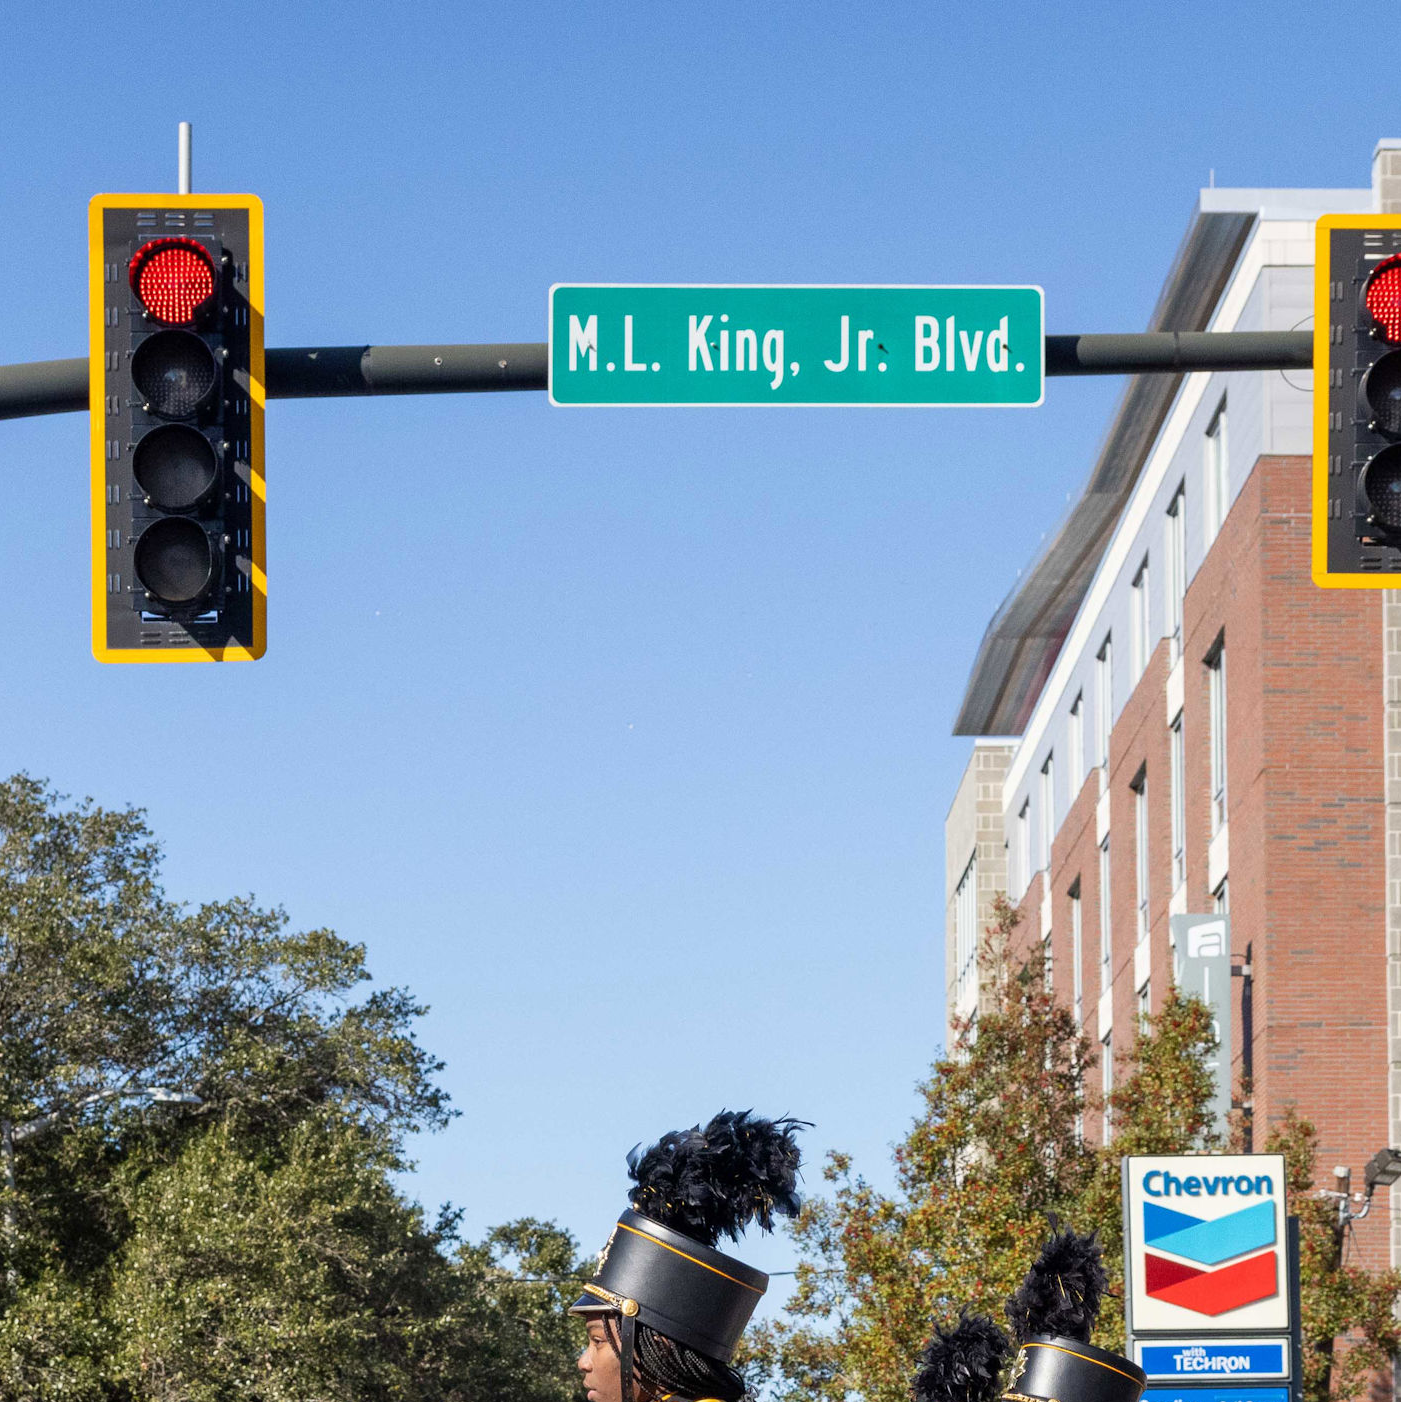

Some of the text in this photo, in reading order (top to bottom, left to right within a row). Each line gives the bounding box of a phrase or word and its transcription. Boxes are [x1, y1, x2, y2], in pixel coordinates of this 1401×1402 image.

[568, 313, 1026, 391] M.L. King, Jr. Blvd.
[1142, 1169, 1274, 1197] Chevron
[1181, 1346, 1207, 1357] with
[1173, 1354, 1251, 1373] TECHRON
